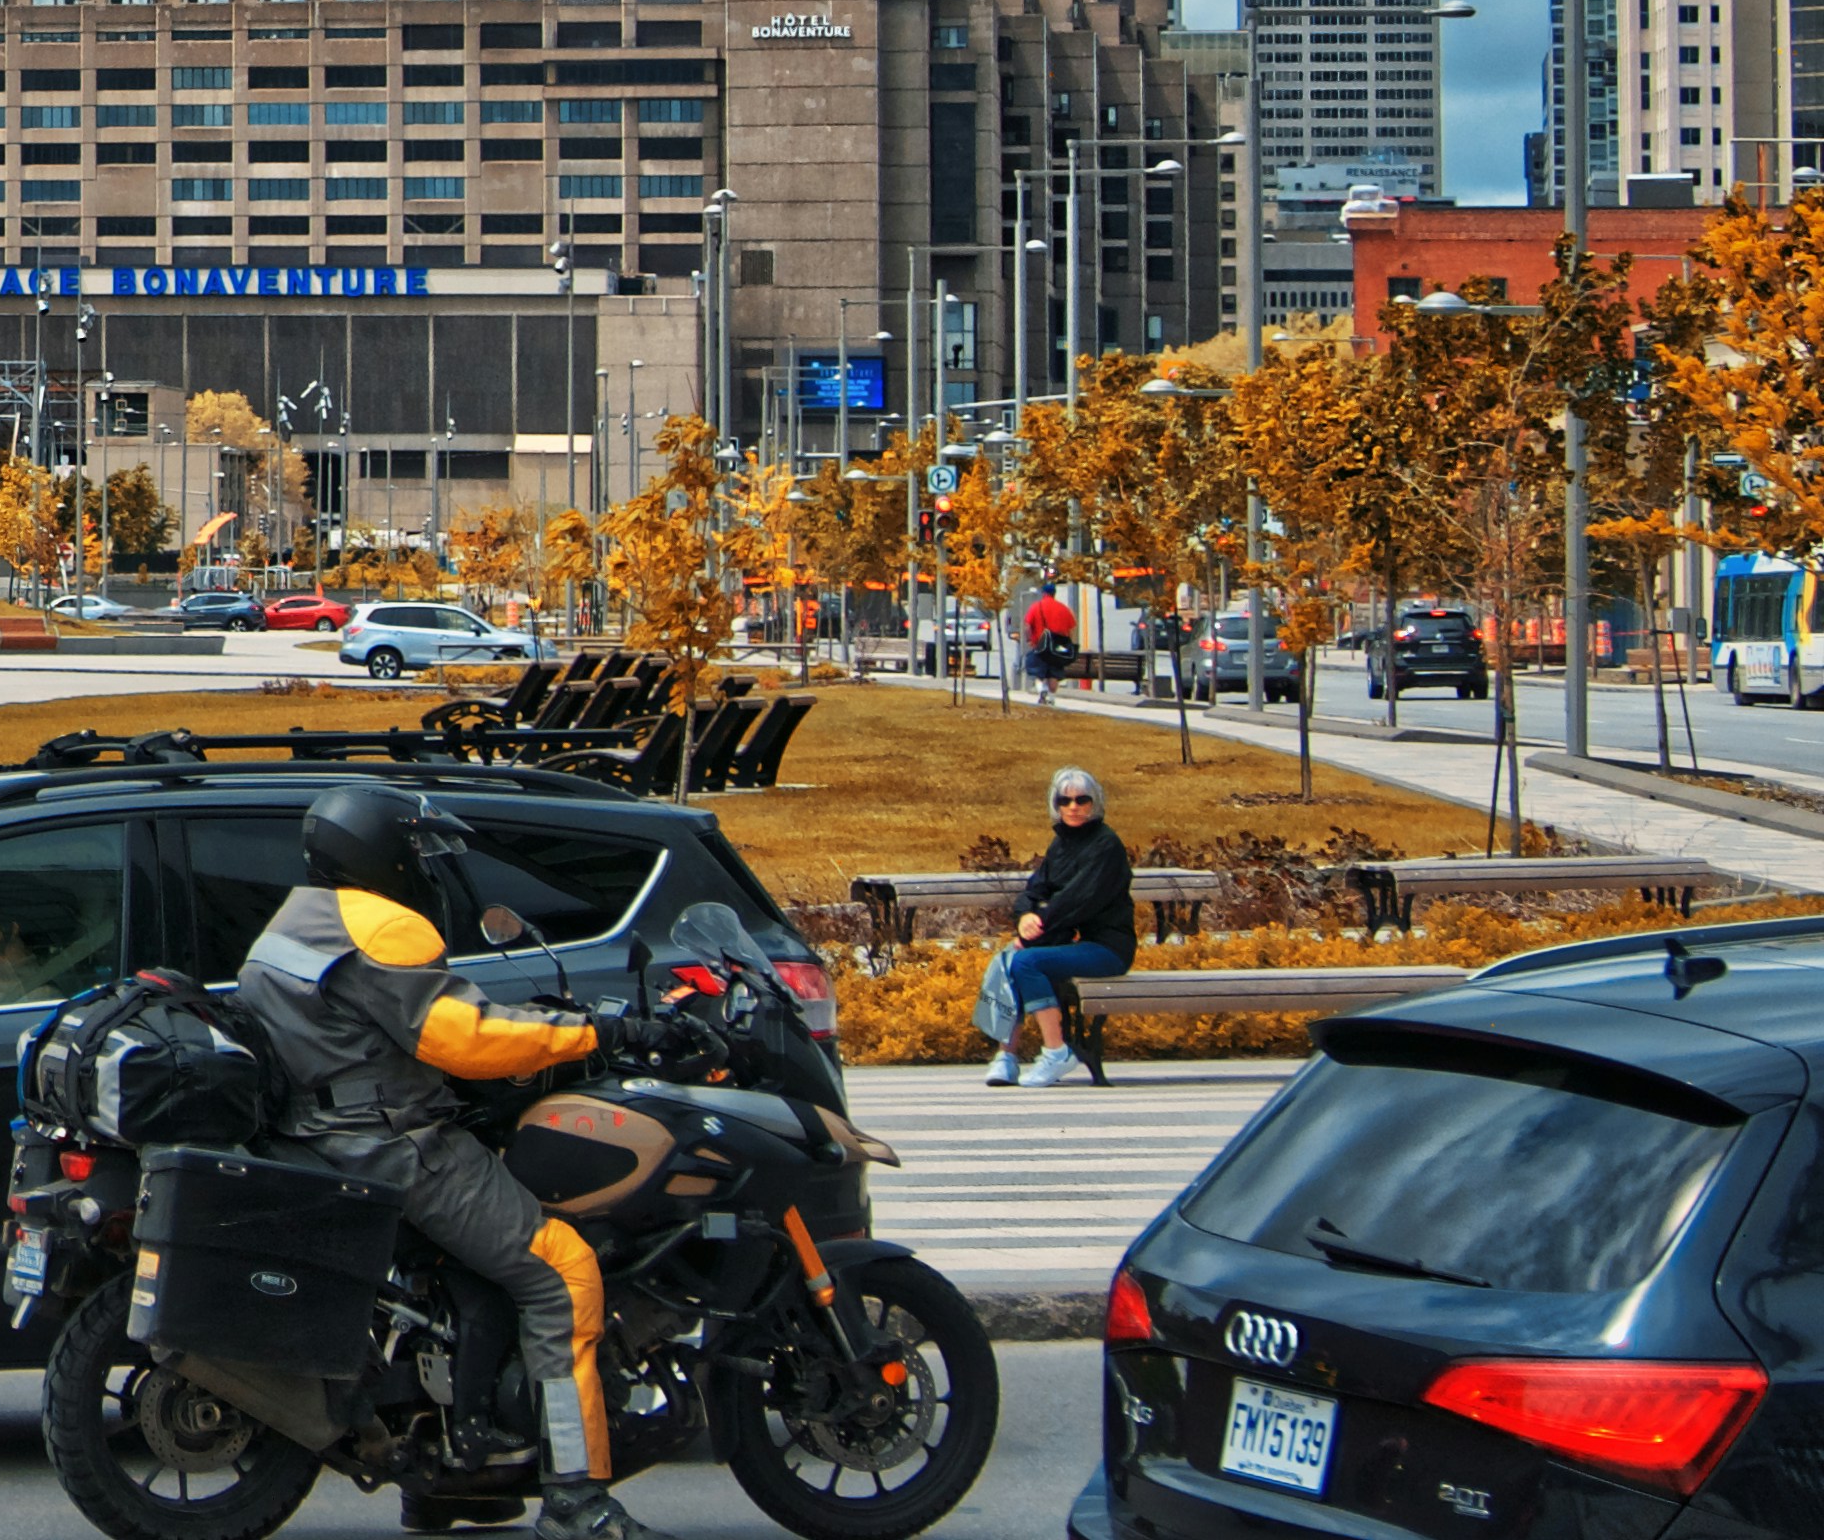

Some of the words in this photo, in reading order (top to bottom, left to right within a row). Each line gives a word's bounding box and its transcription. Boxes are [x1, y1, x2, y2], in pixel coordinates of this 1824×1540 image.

[771, 12, 830, 26] HÔTEL
[752, 26, 851, 38] BONAVENTURE
[113, 267, 431, 296] BONAVENTURE
[1230, 1402, 1327, 1467] FMY5139
